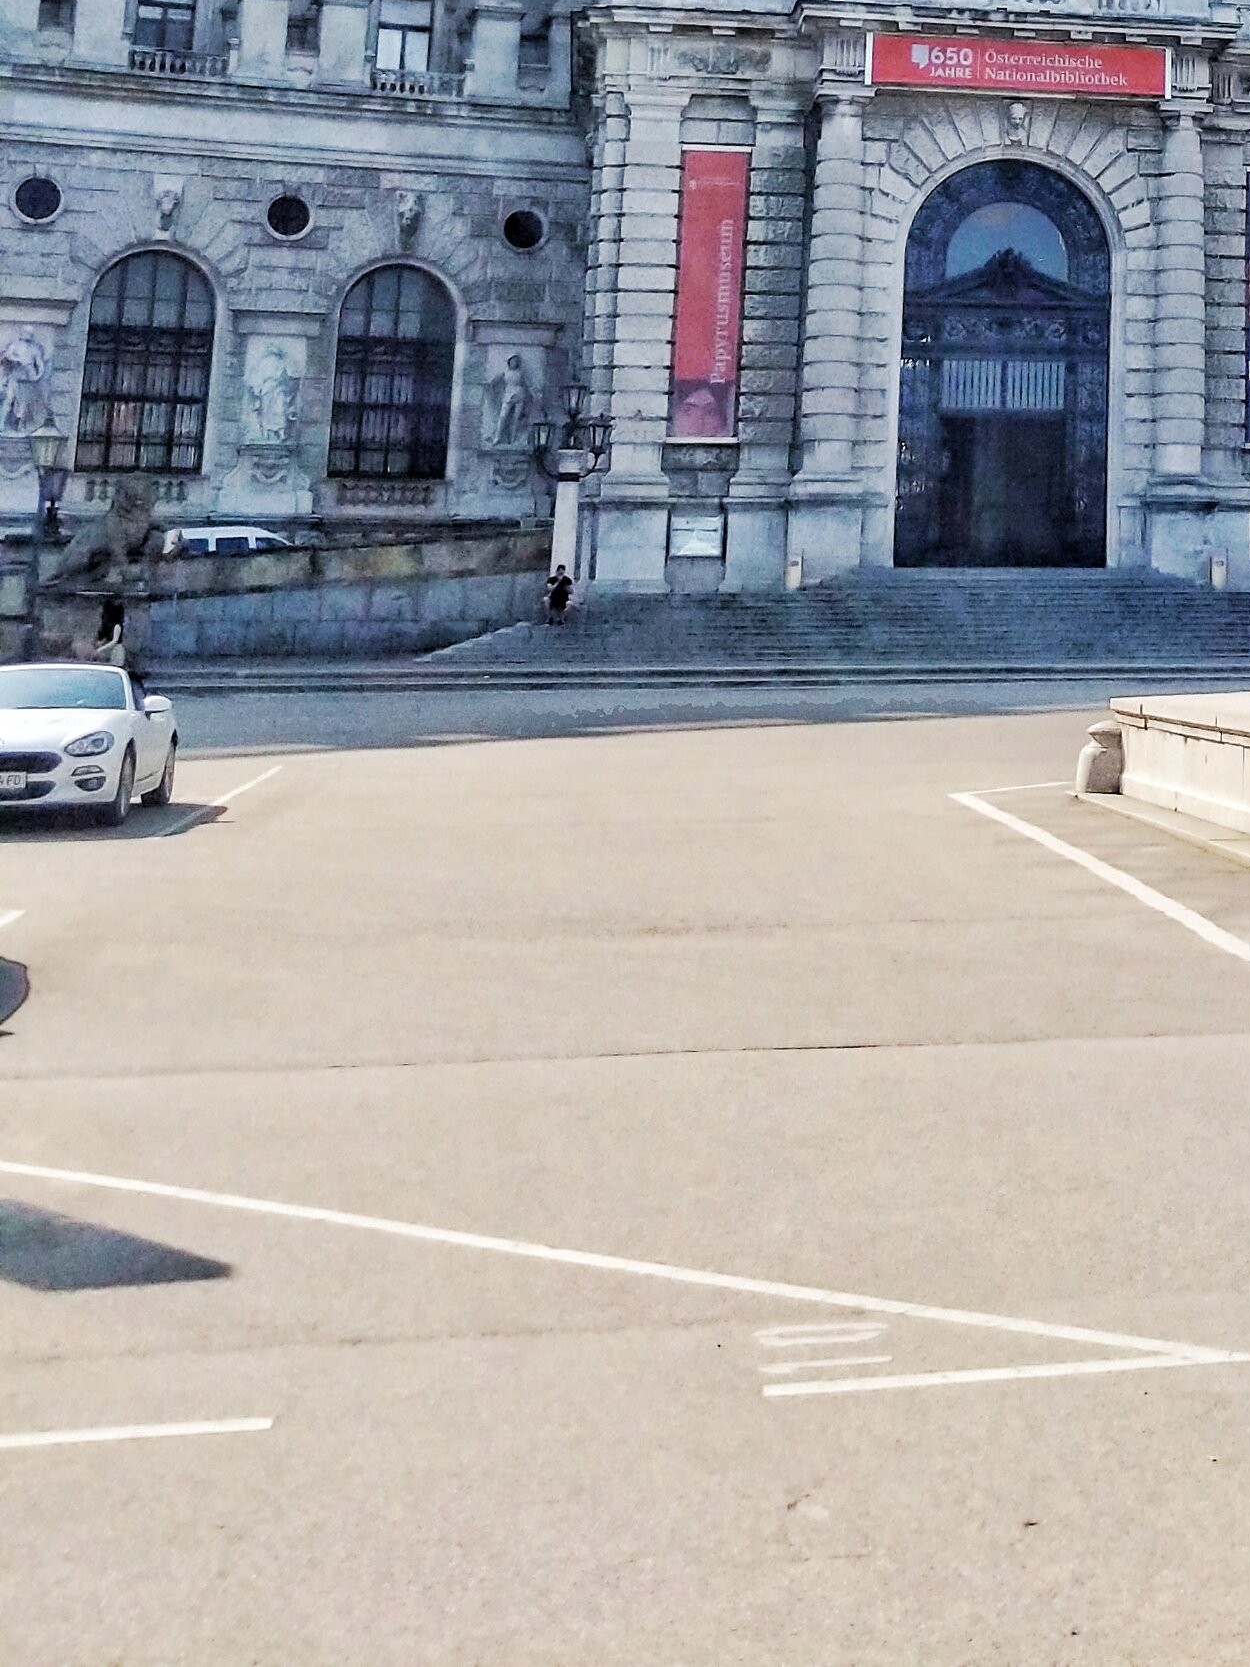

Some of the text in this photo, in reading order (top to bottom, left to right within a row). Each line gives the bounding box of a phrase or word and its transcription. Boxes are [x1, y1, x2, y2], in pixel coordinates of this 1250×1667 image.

[930, 47, 973, 65] 650
[985, 48, 1103, 69] Österreichische
[929, 67, 973, 79] JAHRE
[984, 68, 1128, 86] Nationalbibliothek
[710, 219, 734, 384] Papyrusmuseum
